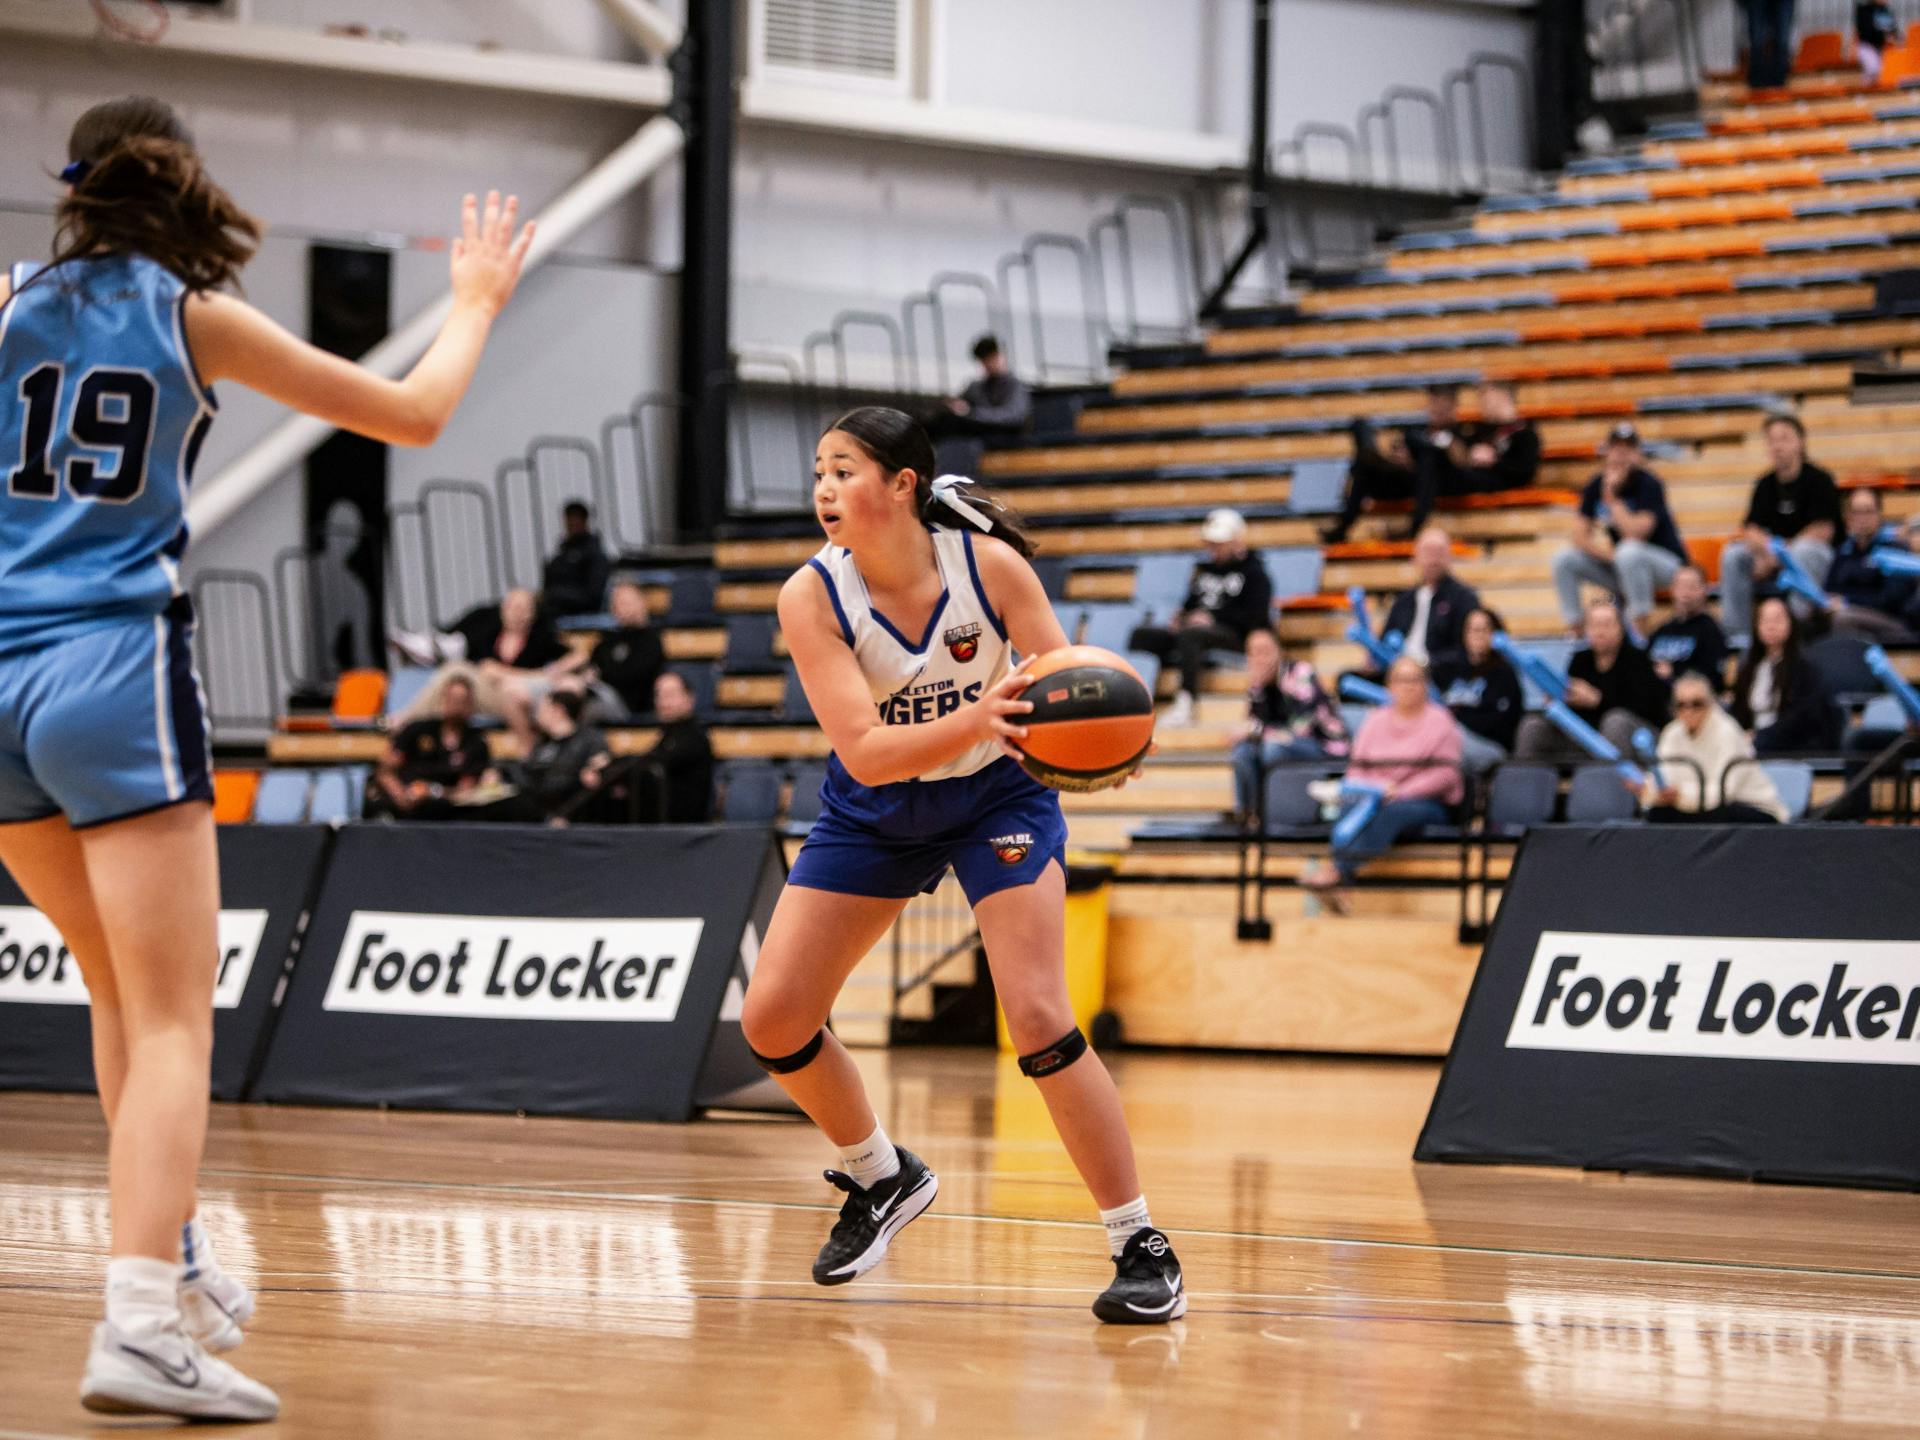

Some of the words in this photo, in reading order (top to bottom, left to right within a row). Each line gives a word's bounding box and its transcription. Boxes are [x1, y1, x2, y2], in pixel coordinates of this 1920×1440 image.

[8, 361, 160, 505] 19
[348, 933, 470, 995] Foot
[484, 936, 676, 1001] Locker
[1531, 955, 1682, 1031] Foot
